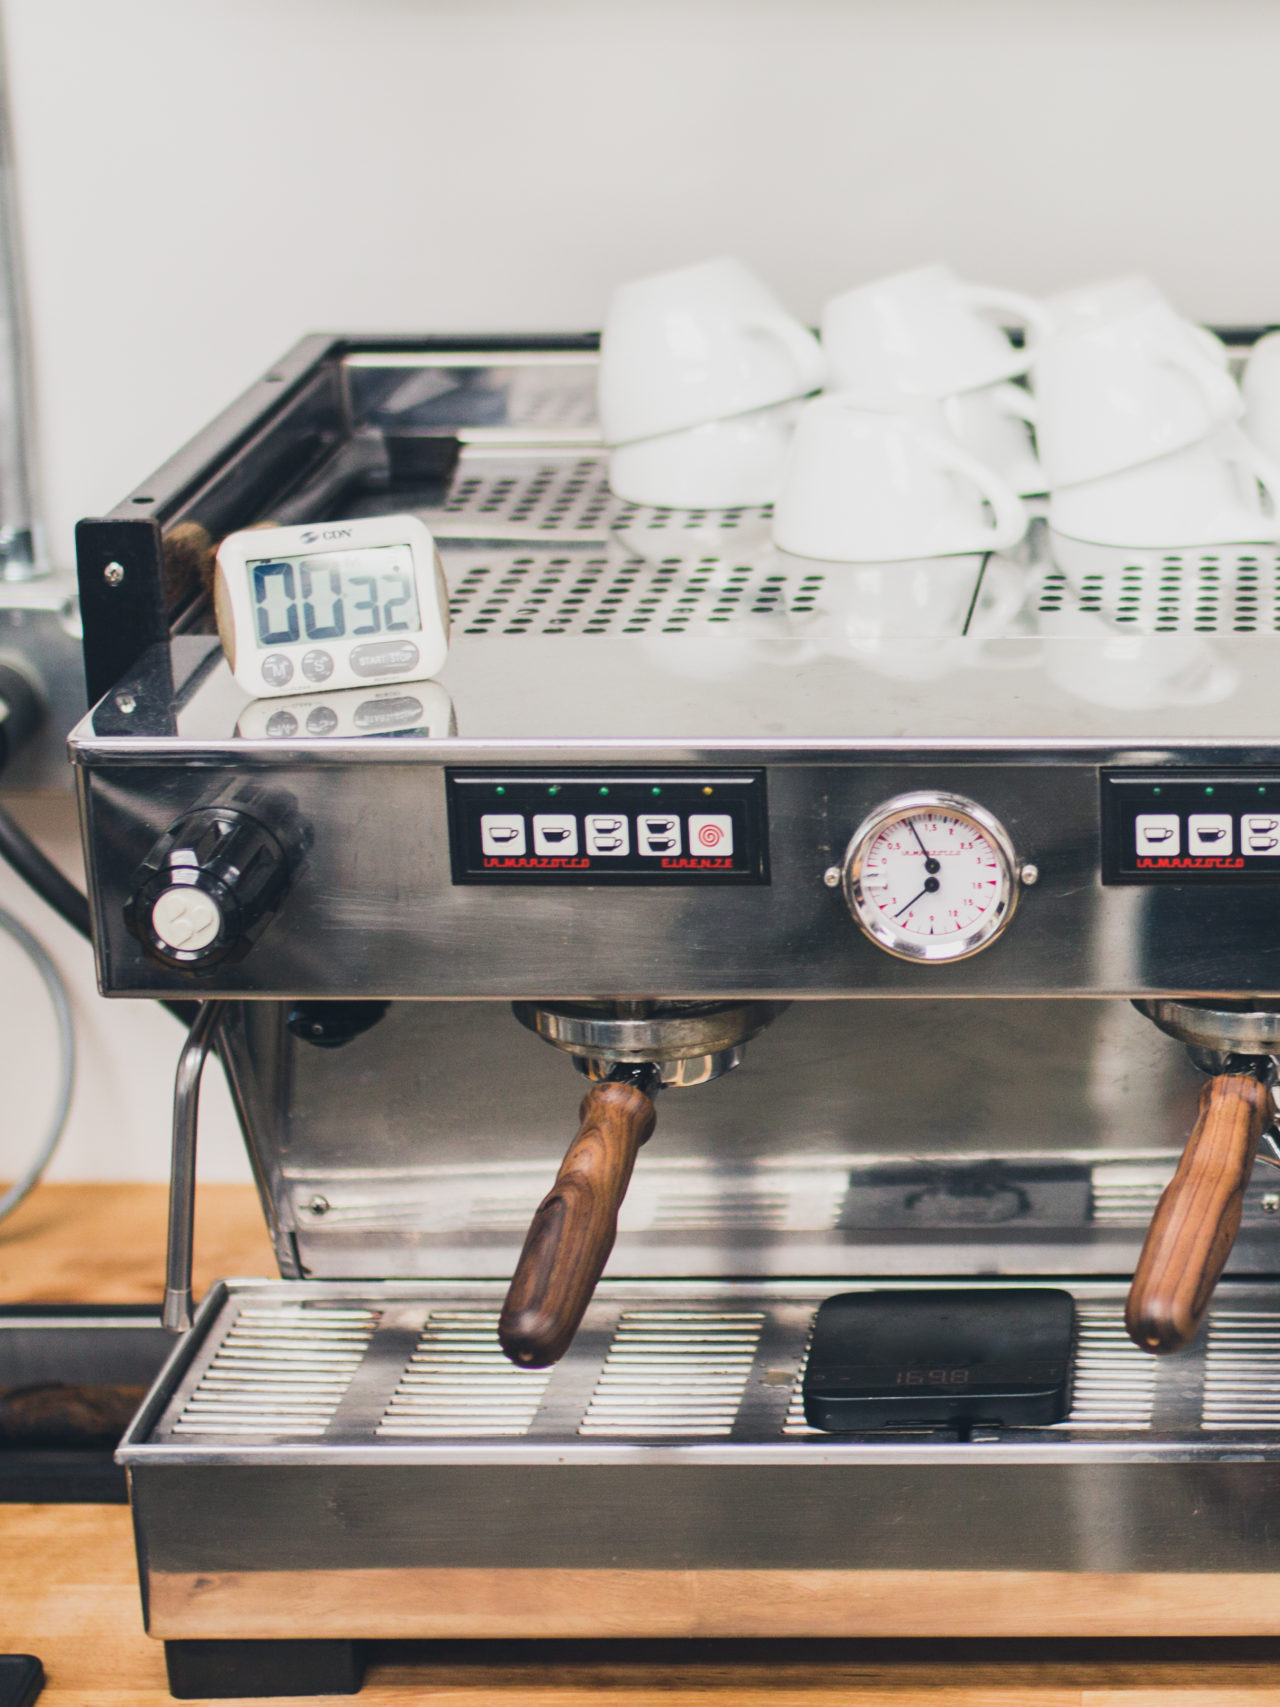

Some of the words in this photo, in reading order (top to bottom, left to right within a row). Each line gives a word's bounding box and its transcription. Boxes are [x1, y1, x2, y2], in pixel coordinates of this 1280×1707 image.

[322, 529, 351, 540] CDN
[271, 661, 287, 678] M
[313, 658, 325, 672] S
